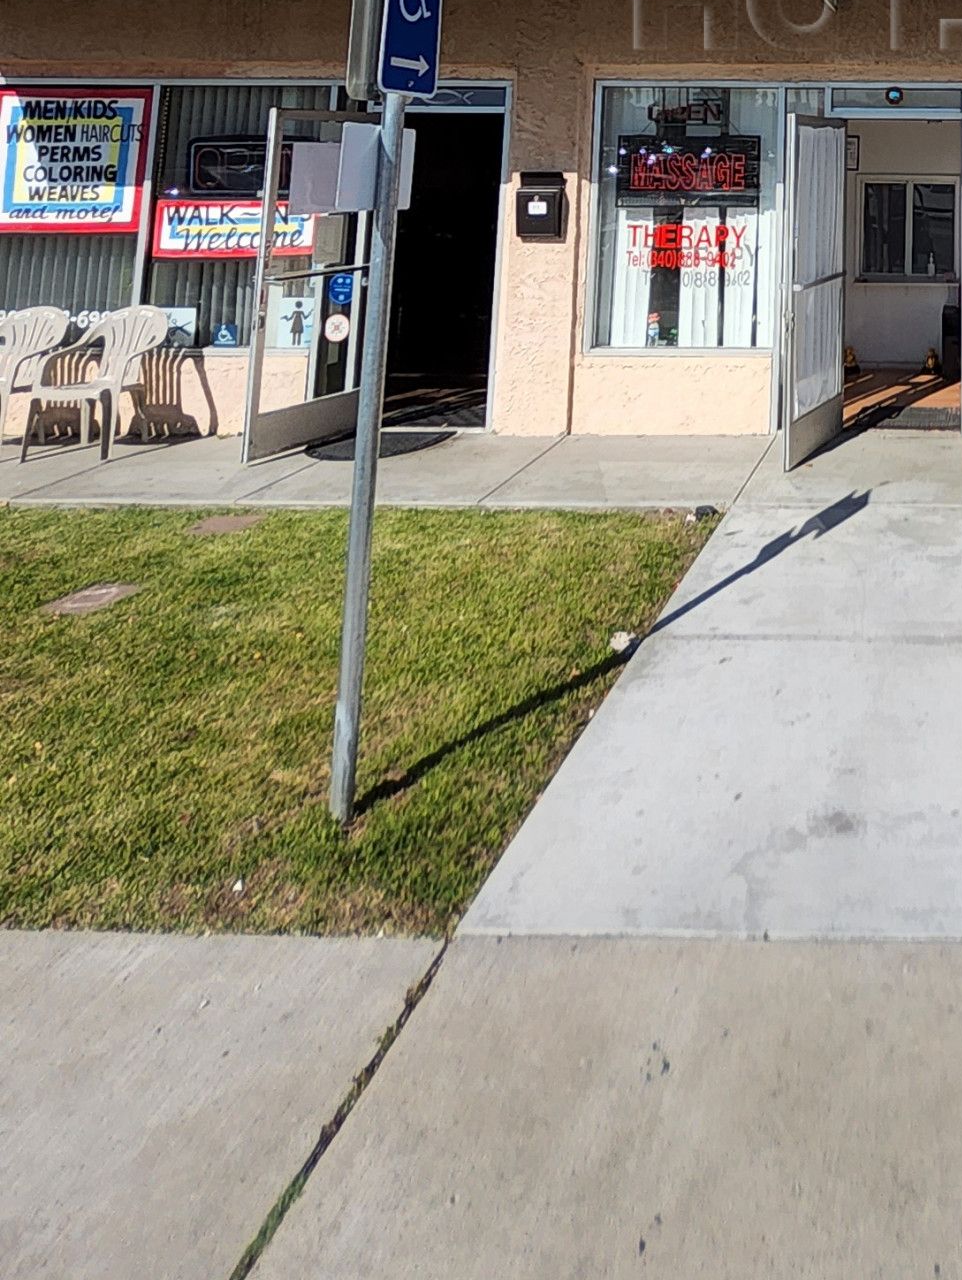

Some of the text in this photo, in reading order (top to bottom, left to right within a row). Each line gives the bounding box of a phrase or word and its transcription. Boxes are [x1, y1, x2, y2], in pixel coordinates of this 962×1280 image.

[23, 100, 119, 123] MEN/KIDS
[7, 124, 144, 144] WOMEN HAIRCUTS
[38, 145, 102, 163] PERMS
[23, 165, 118, 183] COLORING
[630, 152, 746, 191] MASSAGE
[28, 185, 100, 202] WEAVES
[9, 204, 121, 222] and more!
[627, 224, 748, 248] THERAPY
